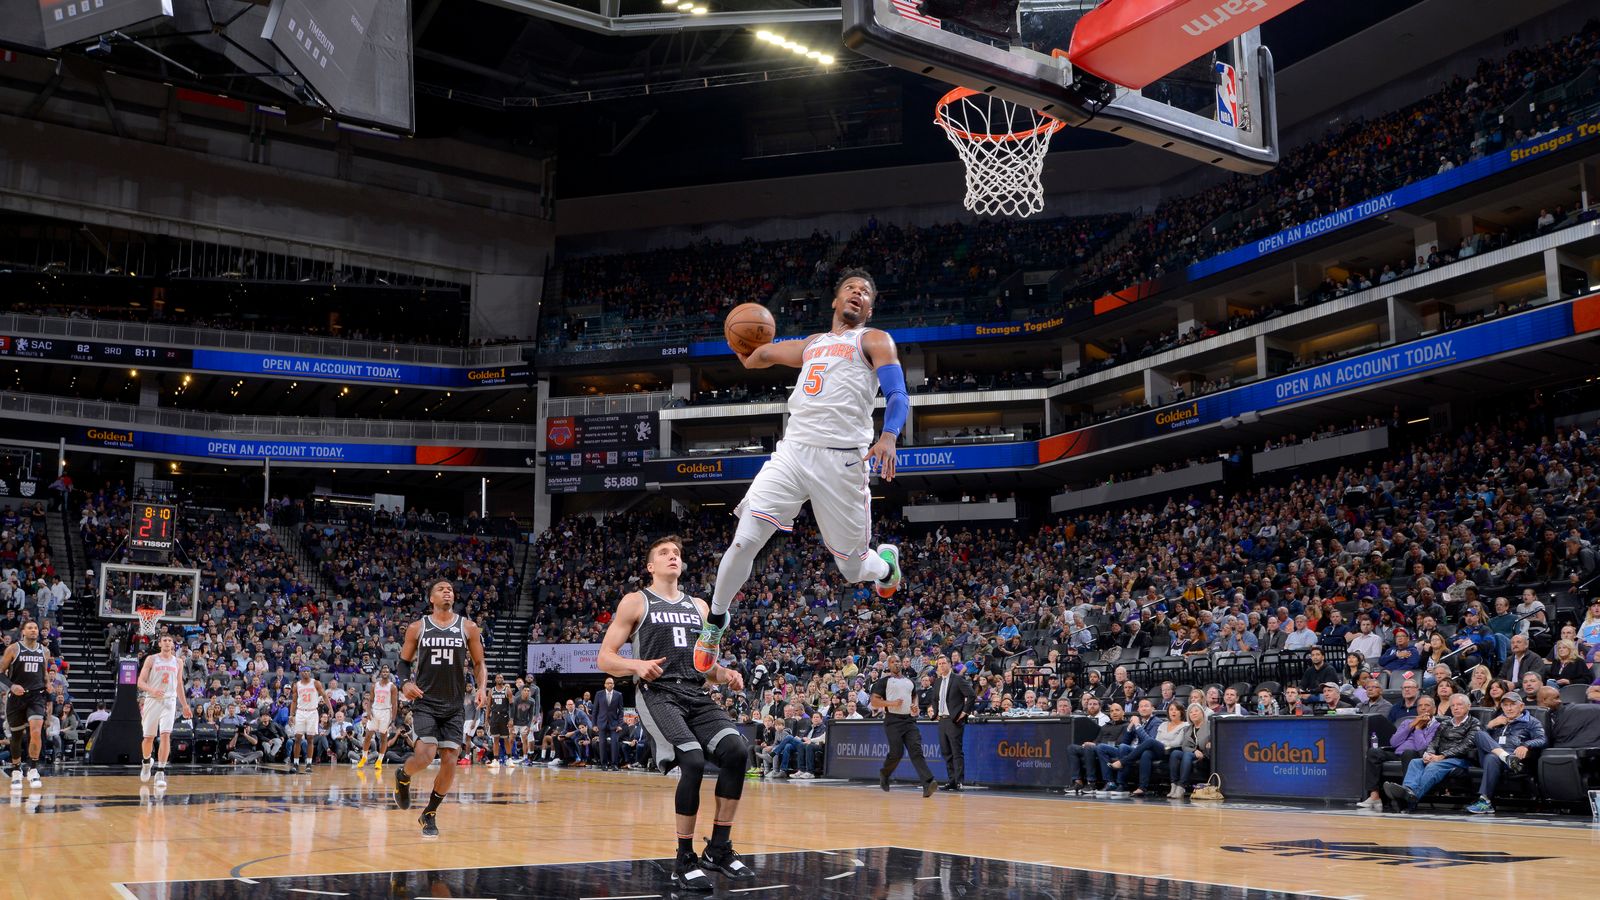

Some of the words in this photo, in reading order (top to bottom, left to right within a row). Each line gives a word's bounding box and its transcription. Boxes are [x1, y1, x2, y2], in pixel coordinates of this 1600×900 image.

[308, 19, 335, 55] TIMEOUTS
[1510, 133, 1574, 161] Stronger
[1258, 234, 1284, 253] OPEN
[1287, 227, 1302, 243] AN
[1305, 208, 1354, 237] ACCOUNT
[1356, 194, 1396, 217] TODAY.
[976, 325, 1021, 335] Stronger
[1023, 317, 1064, 332] Together
[31, 340, 52, 350] SAC
[77, 344, 90, 353] 62
[104, 346, 122, 355] 3RD
[825, 343, 856, 363] YORK
[262, 358, 291, 371] OPEN
[294, 360, 310, 372] AN
[313, 362, 363, 375] ACCOUNT
[365, 365, 401, 378] TODAY.
[1276, 376, 1309, 399] OPEN
[1313, 371, 1332, 390] AN
[1335, 353, 1400, 384] ACCOUNT
[1404, 340, 1456, 367] TODAY.
[803, 362, 828, 397] 5
[208, 442, 236, 454] OPEN
[239, 444, 254, 455] AN
[257, 445, 307, 457] ACCOUNT
[310, 446, 345, 458] TODAY.
[914, 452, 955, 466] TODAY.
[604, 476, 638, 489] $5,880
[145, 507, 171, 520] 8:10
[139, 517, 167, 538] 21
[142, 540, 172, 548] TISSOT
[650, 612, 701, 625] KINGS
[422, 637, 463, 648] KINGS
[672, 626, 688, 647] 8
[430, 648, 454, 665] 24
[24, 662, 39, 673] 00
[837, 742, 857, 757] OPEN
[859, 743, 870, 757] AN
[922, 743, 942, 758] DAY.
[1016, 759, 1034, 768] Credit
[1034, 760, 1052, 769] Union
[1273, 765, 1299, 776] Credit
[1301, 766, 1327, 776] Union
